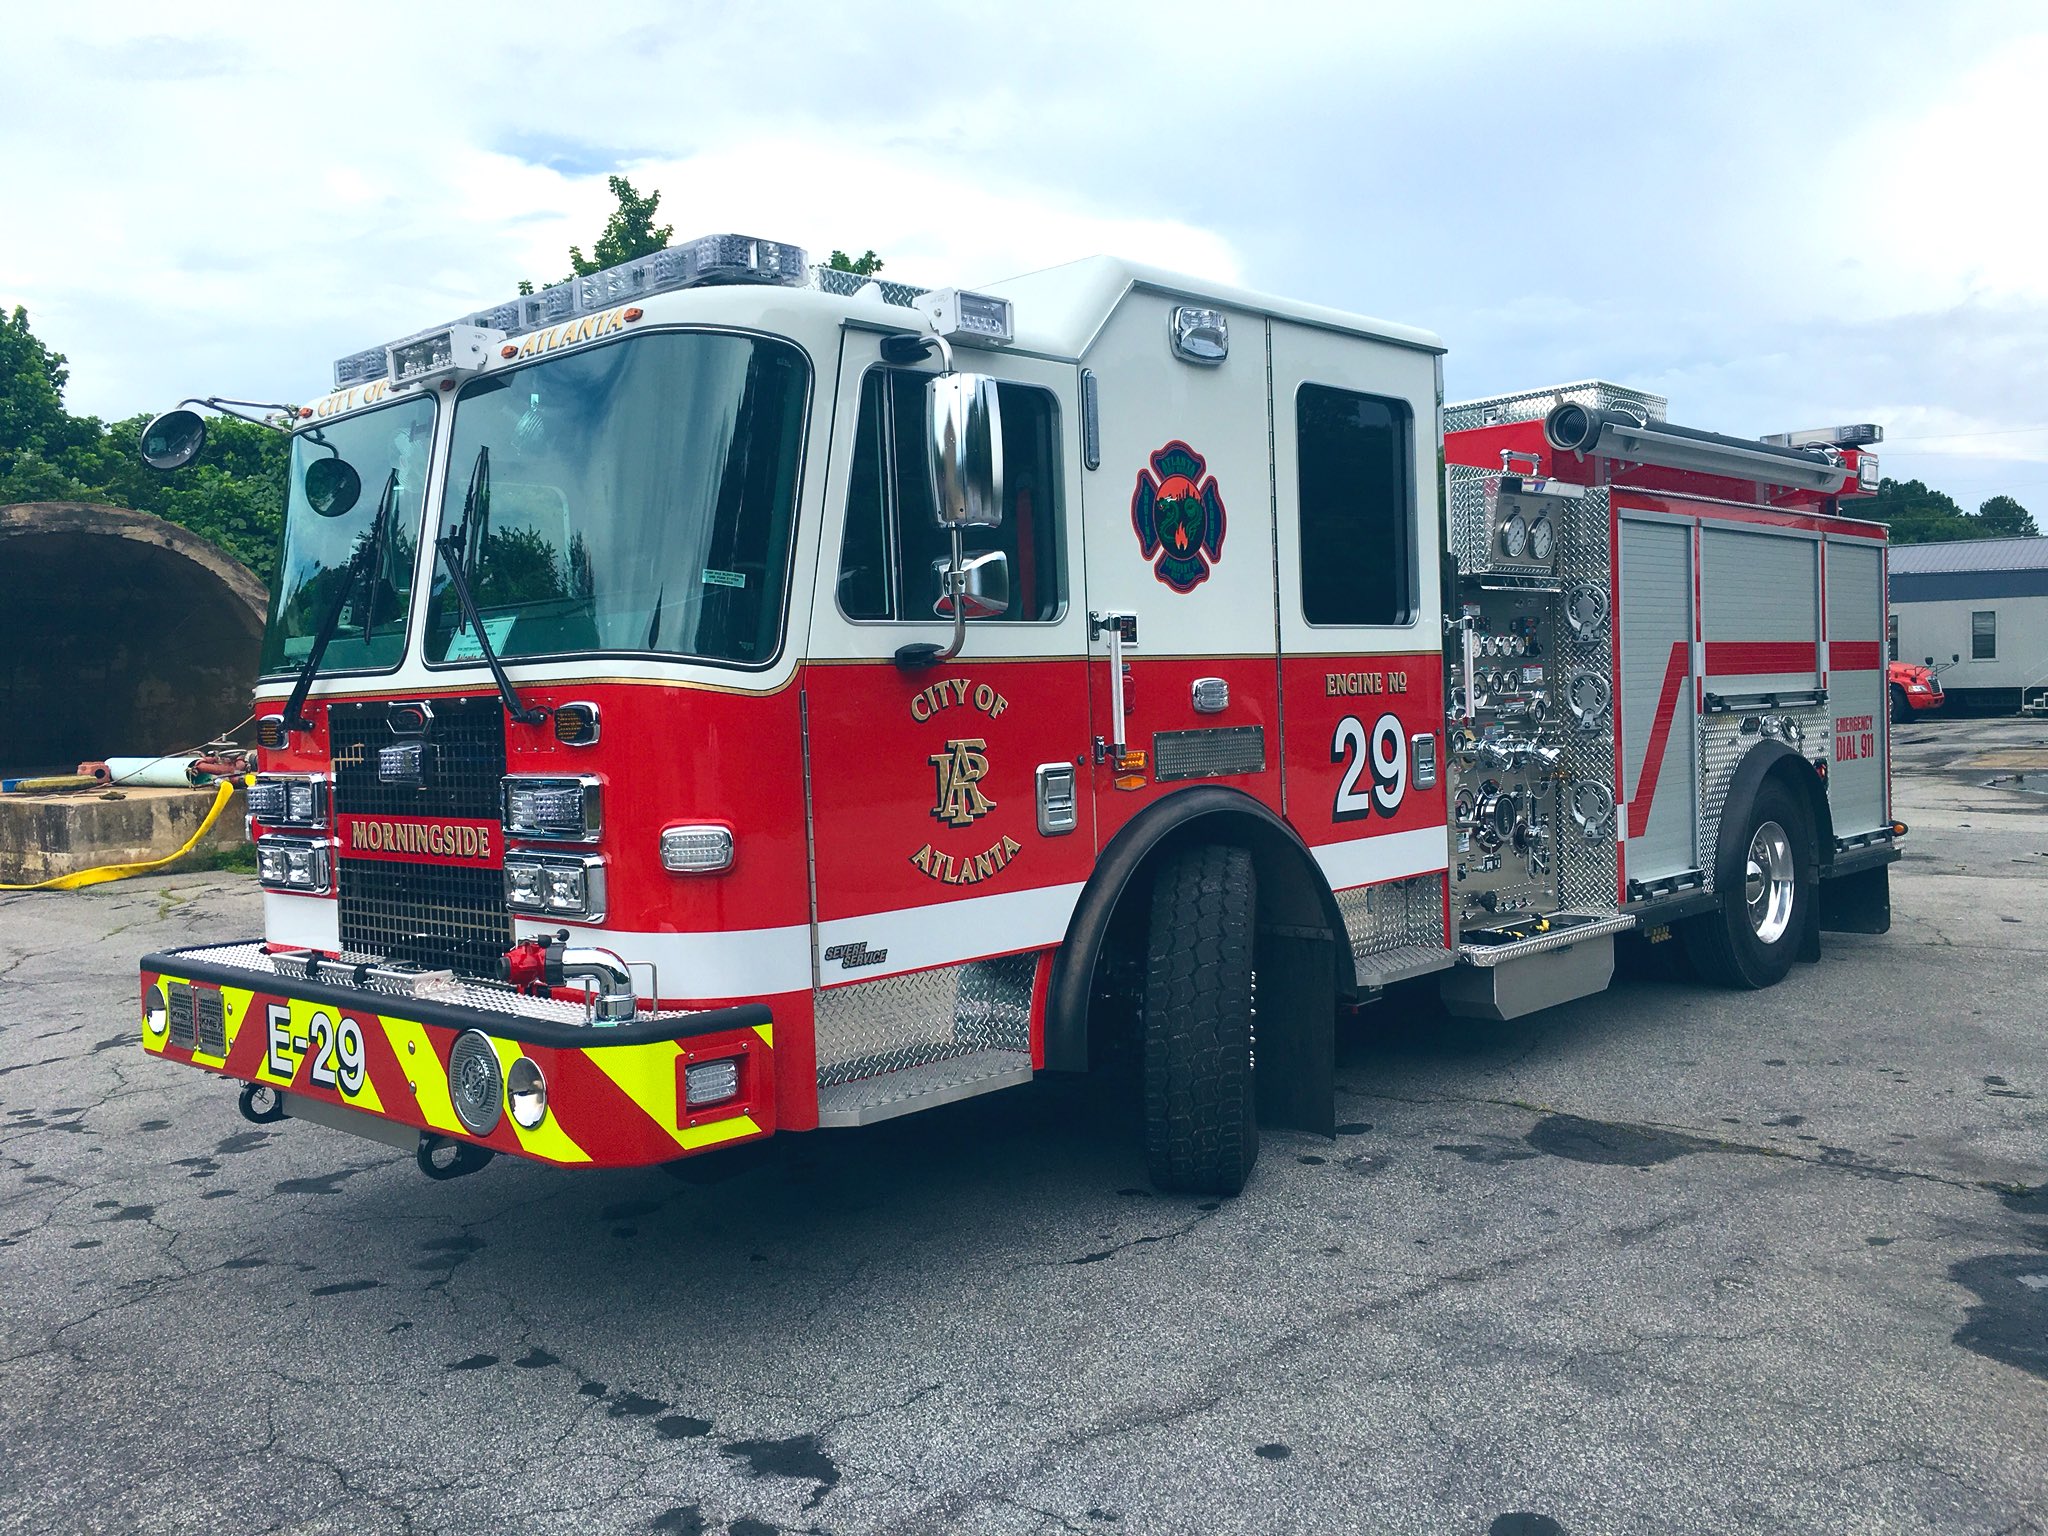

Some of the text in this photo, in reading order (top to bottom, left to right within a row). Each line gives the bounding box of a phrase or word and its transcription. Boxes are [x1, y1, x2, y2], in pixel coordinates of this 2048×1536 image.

[317, 386, 361, 418] CITY
[518, 308, 624, 360] ATLANTA
[911, 678, 1009, 724] CITY OF
[1325, 672, 1383, 697] ENGINE
[1835, 715, 1873, 733] EMERGENCY
[1835, 733, 1874, 762] DIAL 911
[1330, 711, 1408, 824] 29
[351, 820, 491, 859] MORNINGSIDE
[908, 834, 1022, 885] ATLANTA
[825, 941, 868, 961] SEVERE
[842, 949, 888, 969] SERVICE
[267, 1003, 366, 1097] E-29
